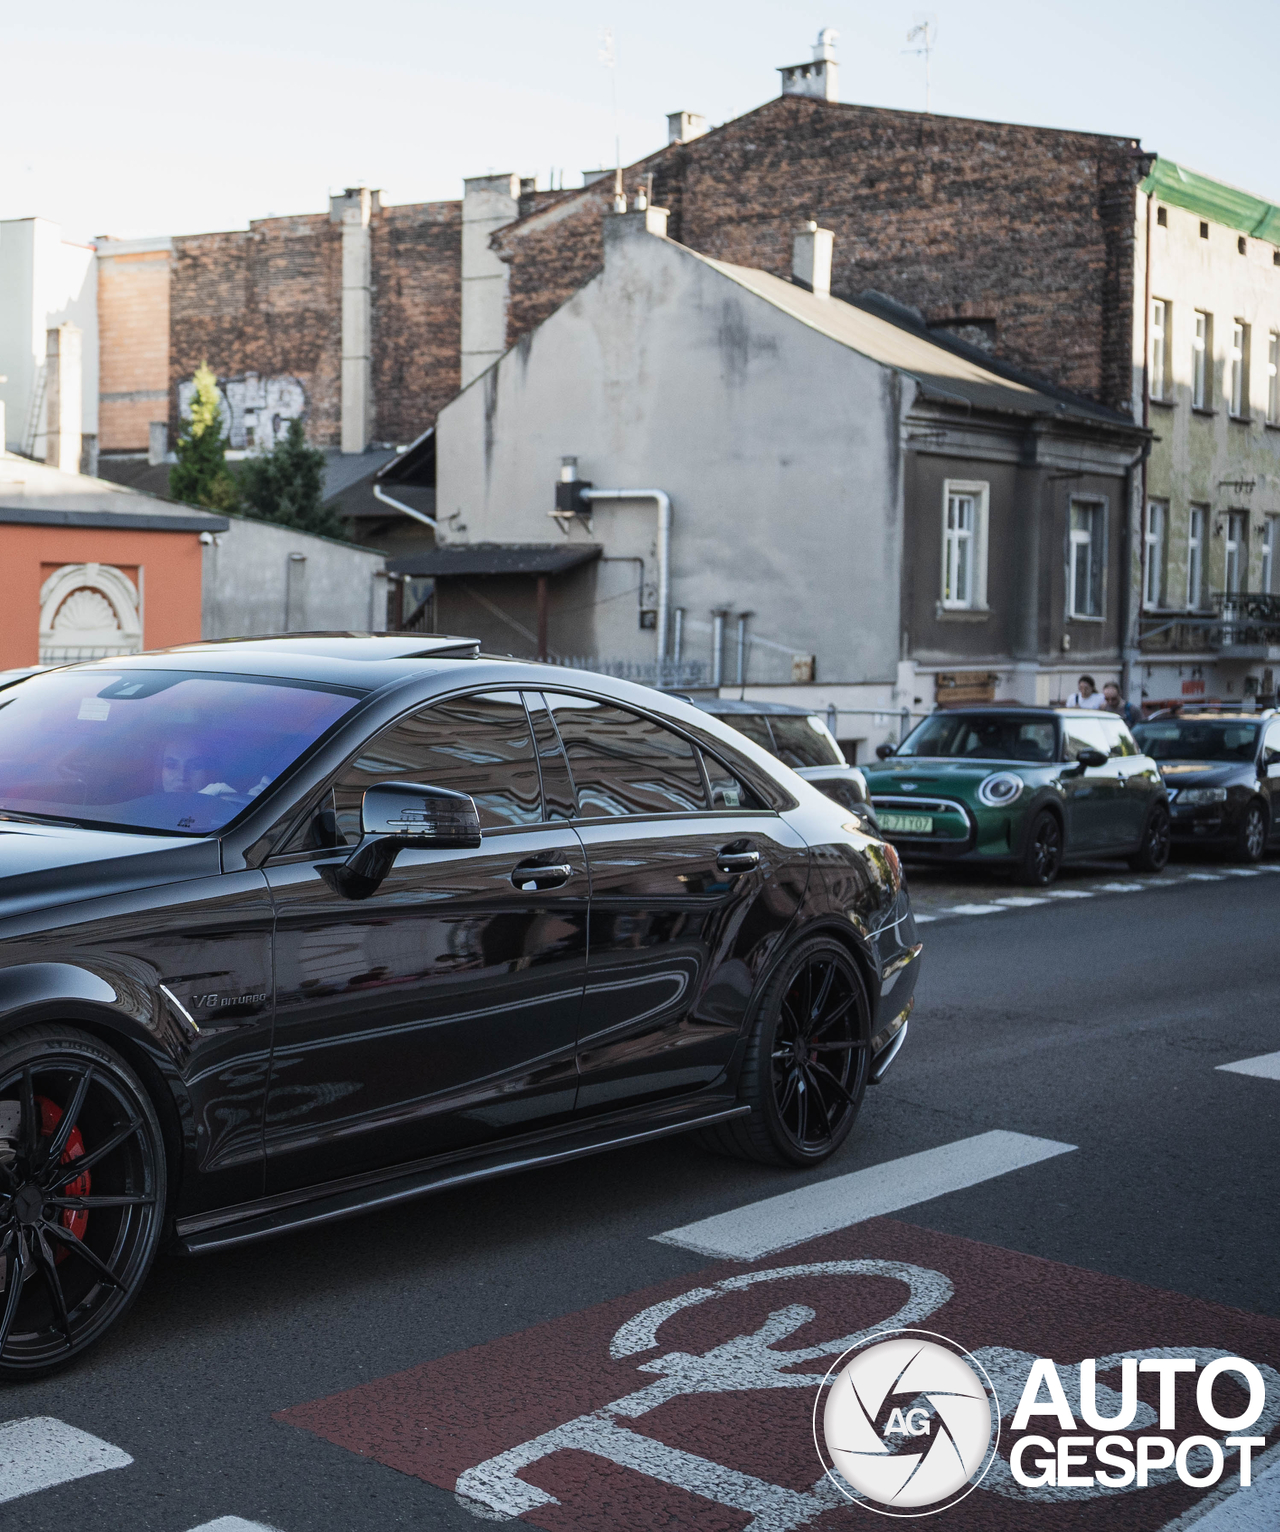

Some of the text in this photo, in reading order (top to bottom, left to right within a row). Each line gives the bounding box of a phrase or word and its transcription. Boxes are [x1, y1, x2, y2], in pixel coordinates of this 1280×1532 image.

[893, 815, 928, 830] 7TY07
[192, 993, 266, 1008] V8 BITURBO
